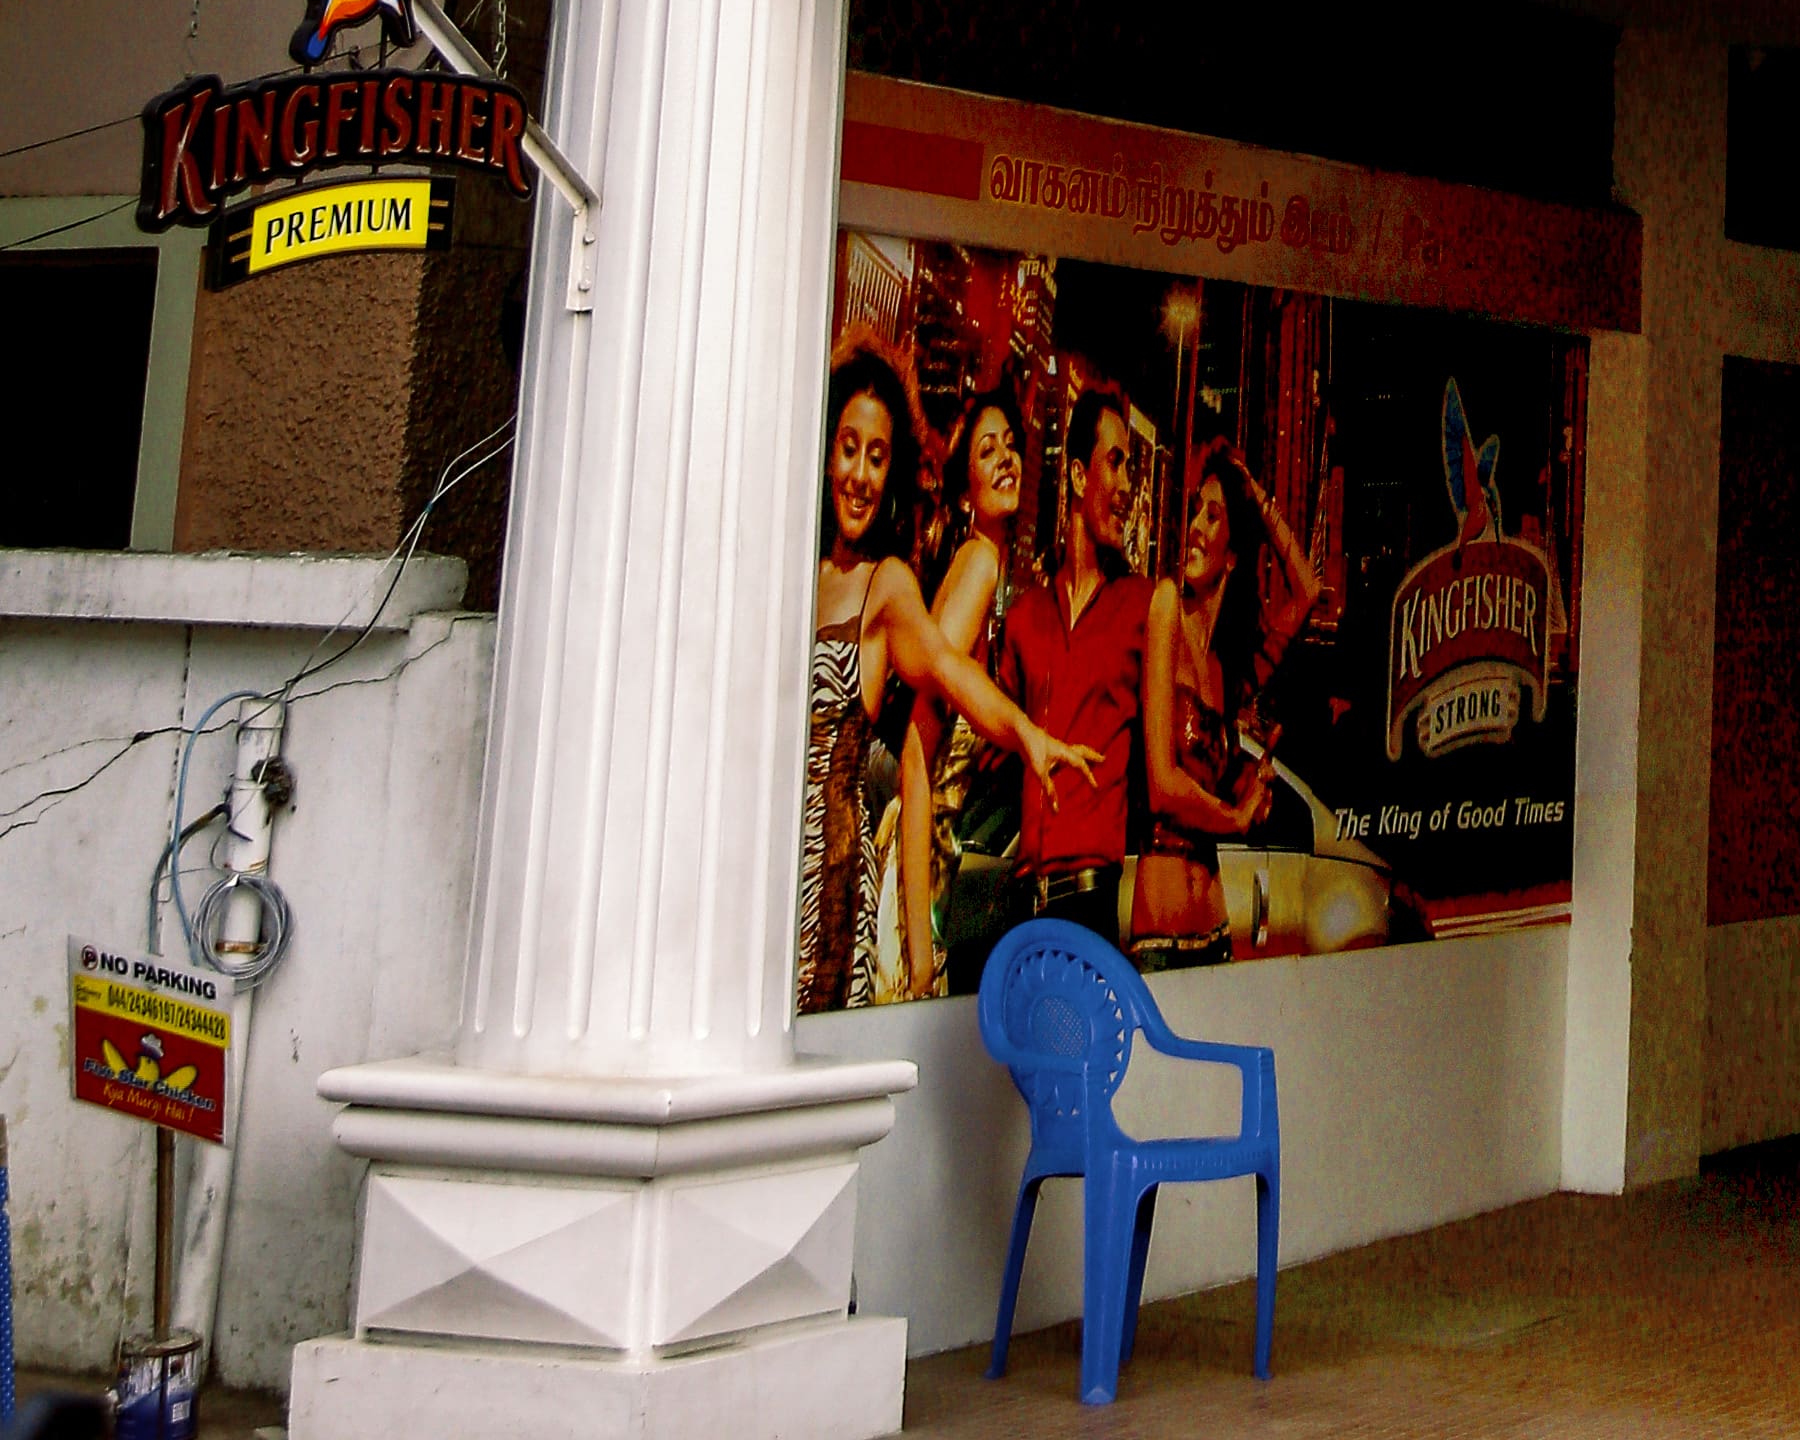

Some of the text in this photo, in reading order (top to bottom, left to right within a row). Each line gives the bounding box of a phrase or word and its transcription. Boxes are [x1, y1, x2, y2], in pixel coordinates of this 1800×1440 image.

[156, 77, 532, 220] KINGFISHER
[264, 197, 412, 256] PREMIUM
[990, 152, 1128, 219] வாகனம்
[1133, 162, 1275, 255] நிறுத்தும்
[1399, 572, 1538, 680] KINGFISHER
[1435, 688, 1500, 734] STRONG
[1334, 796, 1565, 841] The King of Good Times
[100, 952, 129, 976] NO
[134, 961, 216, 1000] PARKING
